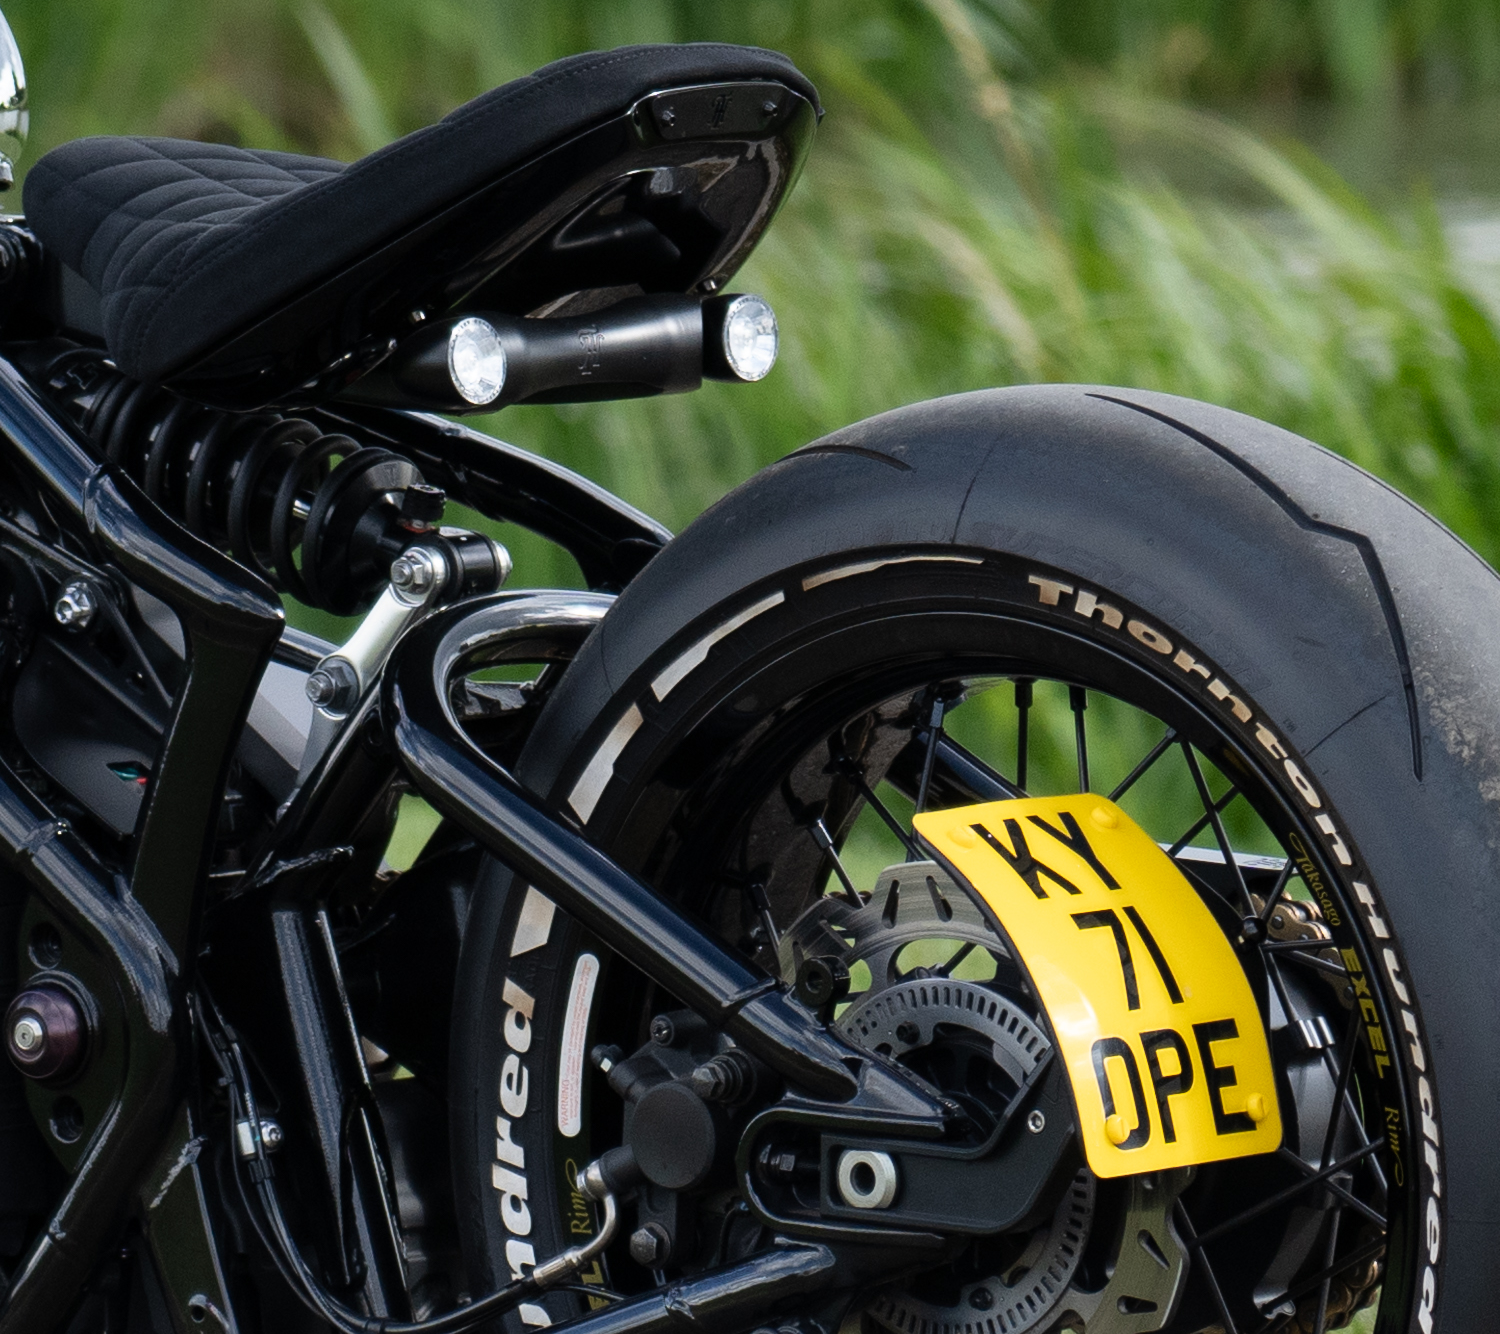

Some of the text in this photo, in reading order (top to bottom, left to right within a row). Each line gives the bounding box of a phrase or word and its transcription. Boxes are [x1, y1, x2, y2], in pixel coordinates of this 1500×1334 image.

[1027, 574, 1353, 867] Thornton
[969, 811, 1123, 900] KY
[1069, 905, 1185, 1011] 71
[1288, 831, 1405, 1187] Takasago EXCEL Rim
[1090, 1017, 1258, 1151] OPE
